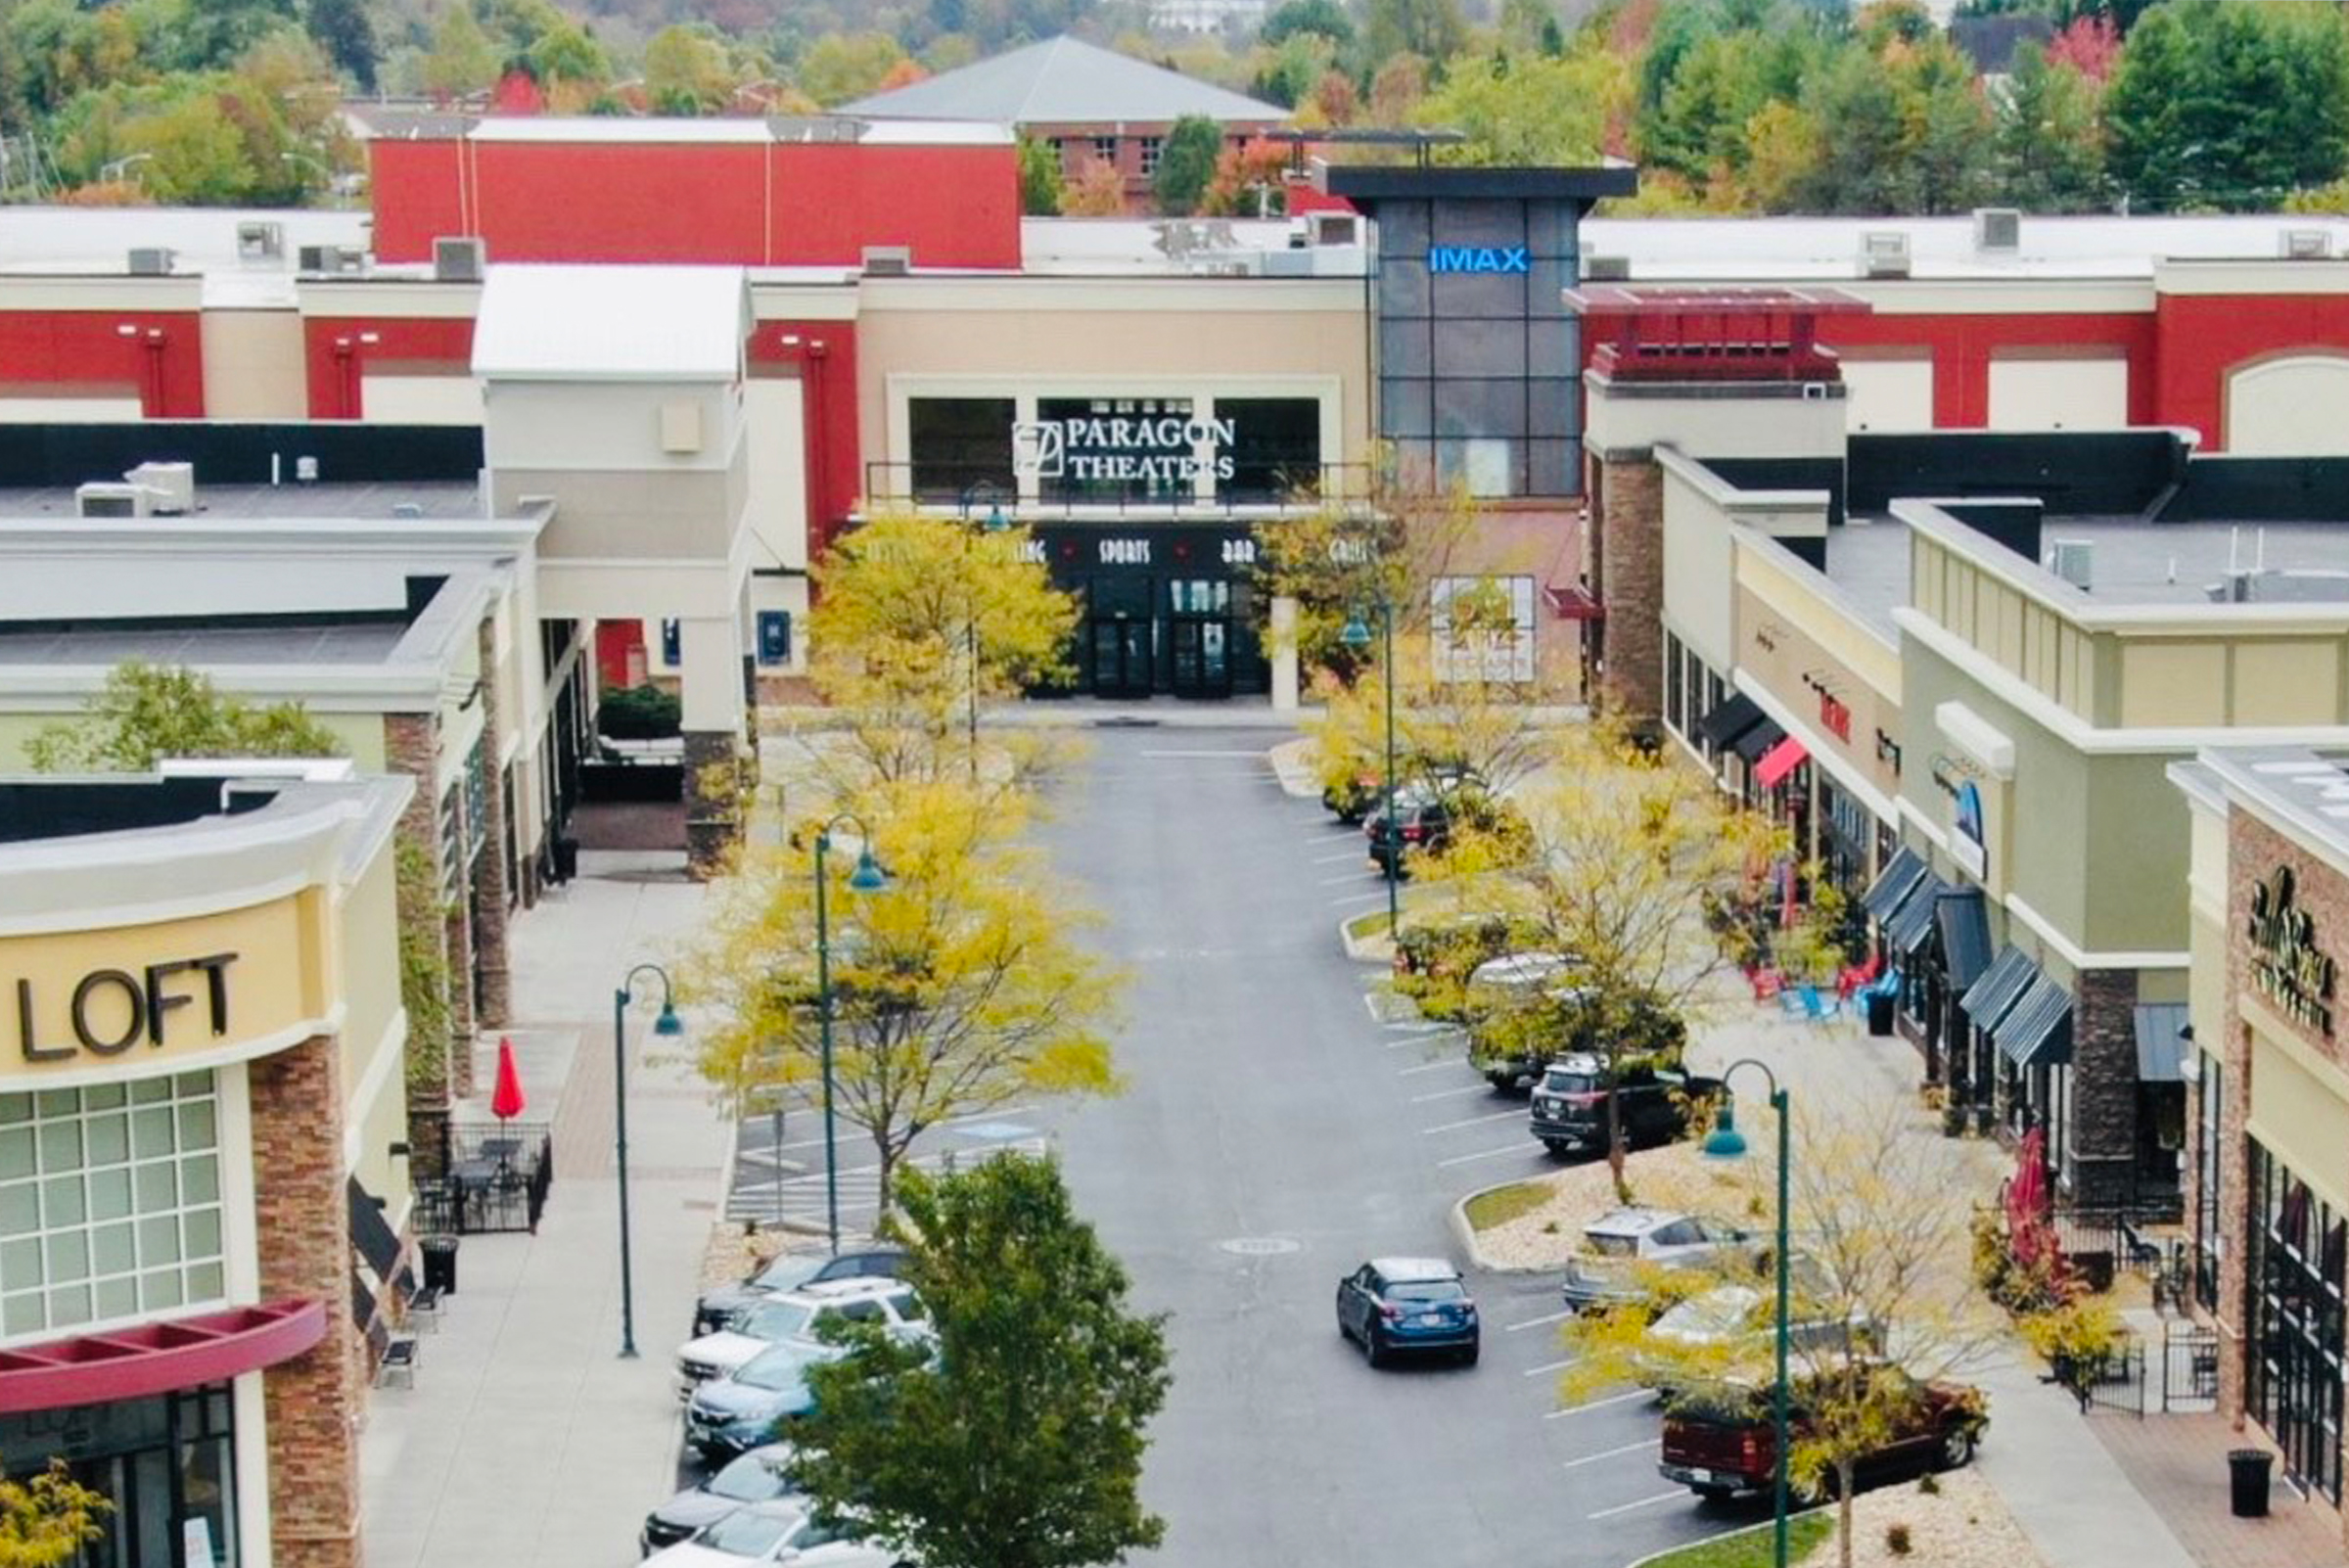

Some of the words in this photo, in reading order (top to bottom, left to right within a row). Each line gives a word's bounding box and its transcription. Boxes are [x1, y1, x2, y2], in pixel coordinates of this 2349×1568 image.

[1430, 247, 1528, 272] IMAX
[1066, 418, 1235, 447] PARAGON
[1068, 455, 1235, 481] THEATERS
[1098, 539, 1151, 564] SPORTS
[1221, 539, 1256, 564] BAR
[18, 952, 239, 1062] LOFT
